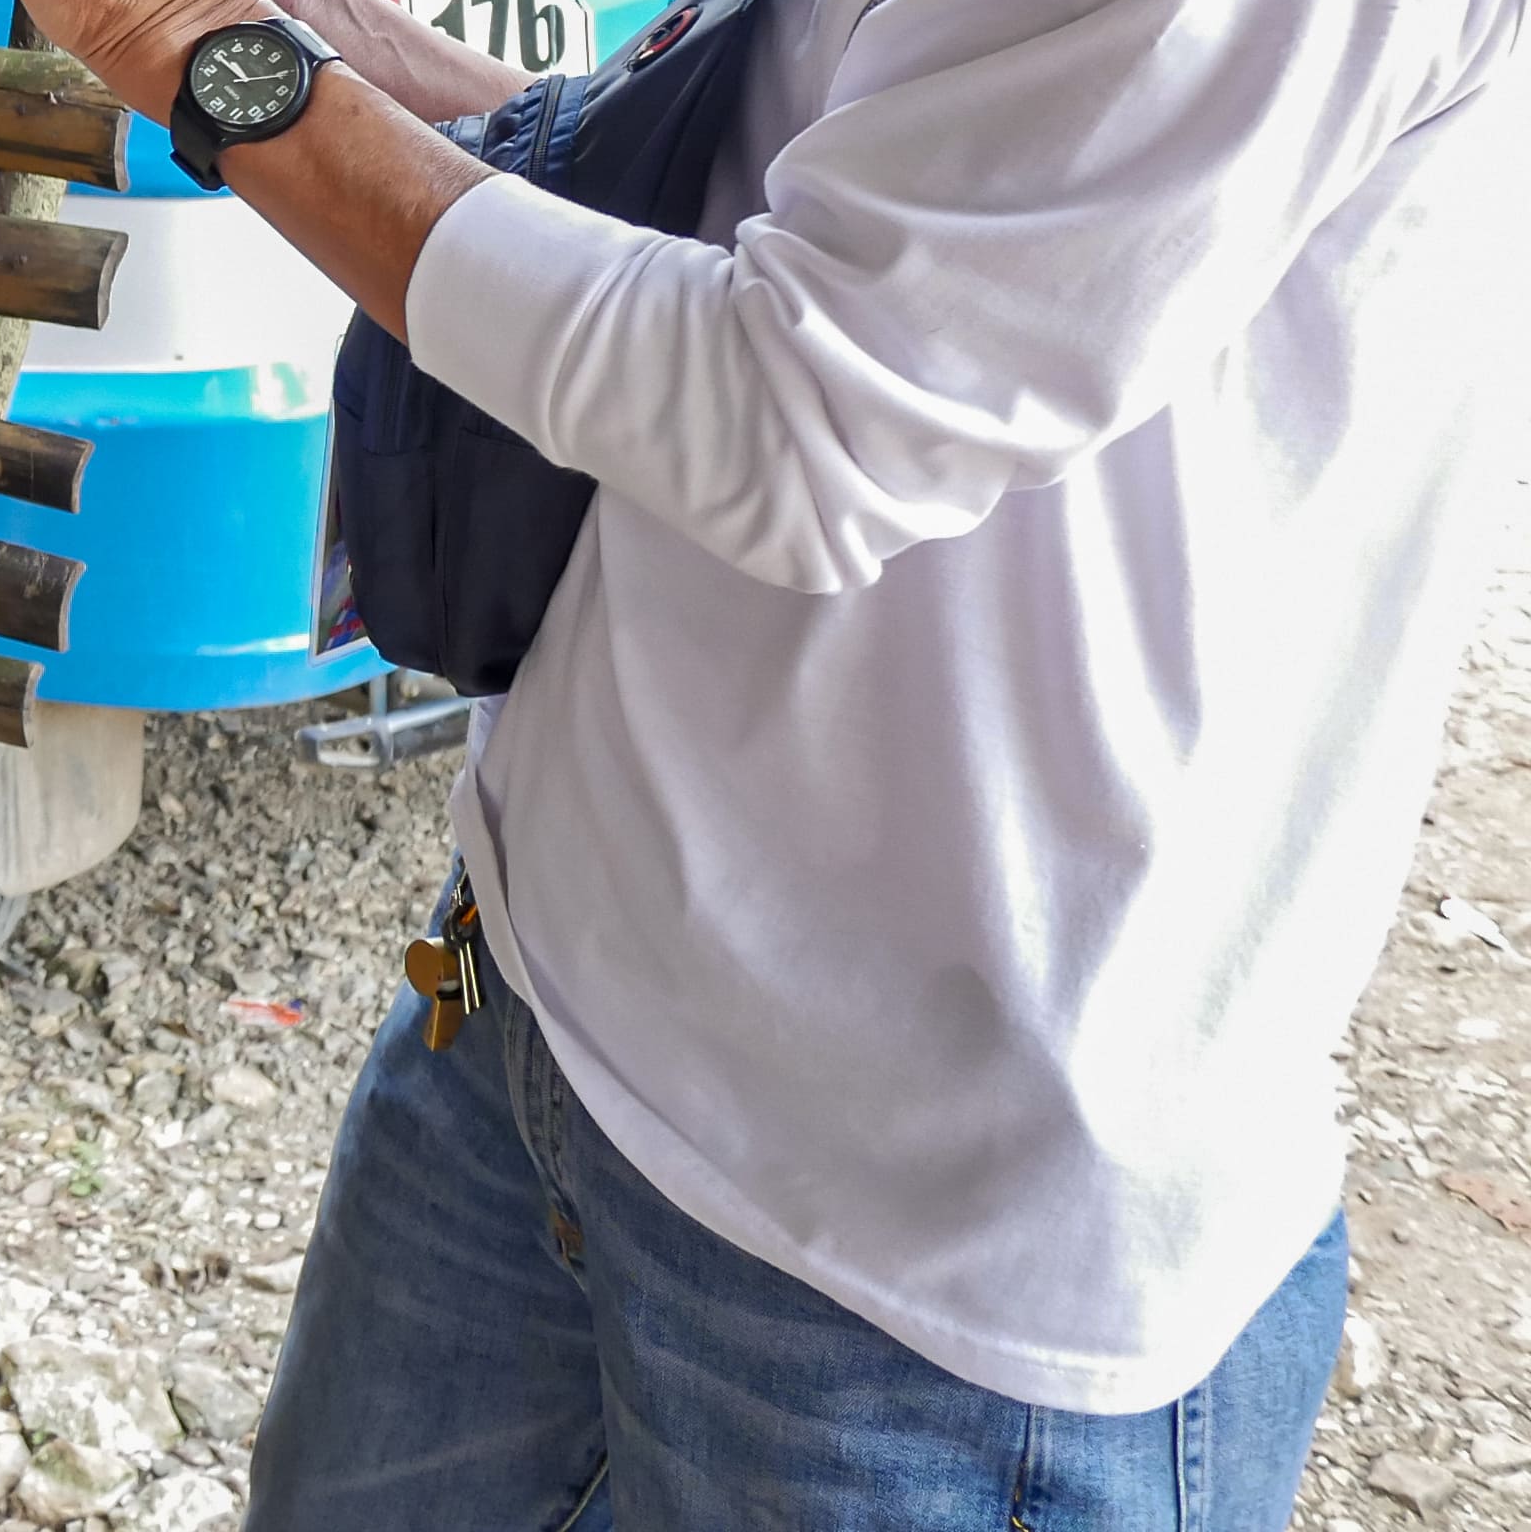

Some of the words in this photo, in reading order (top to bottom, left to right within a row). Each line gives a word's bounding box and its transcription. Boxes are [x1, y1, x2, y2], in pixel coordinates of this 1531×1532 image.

[249, 43, 264, 56] 5
[203, 64, 218, 77] 2
[209, 96, 226, 113] 12
[229, 108, 244, 120] 11
